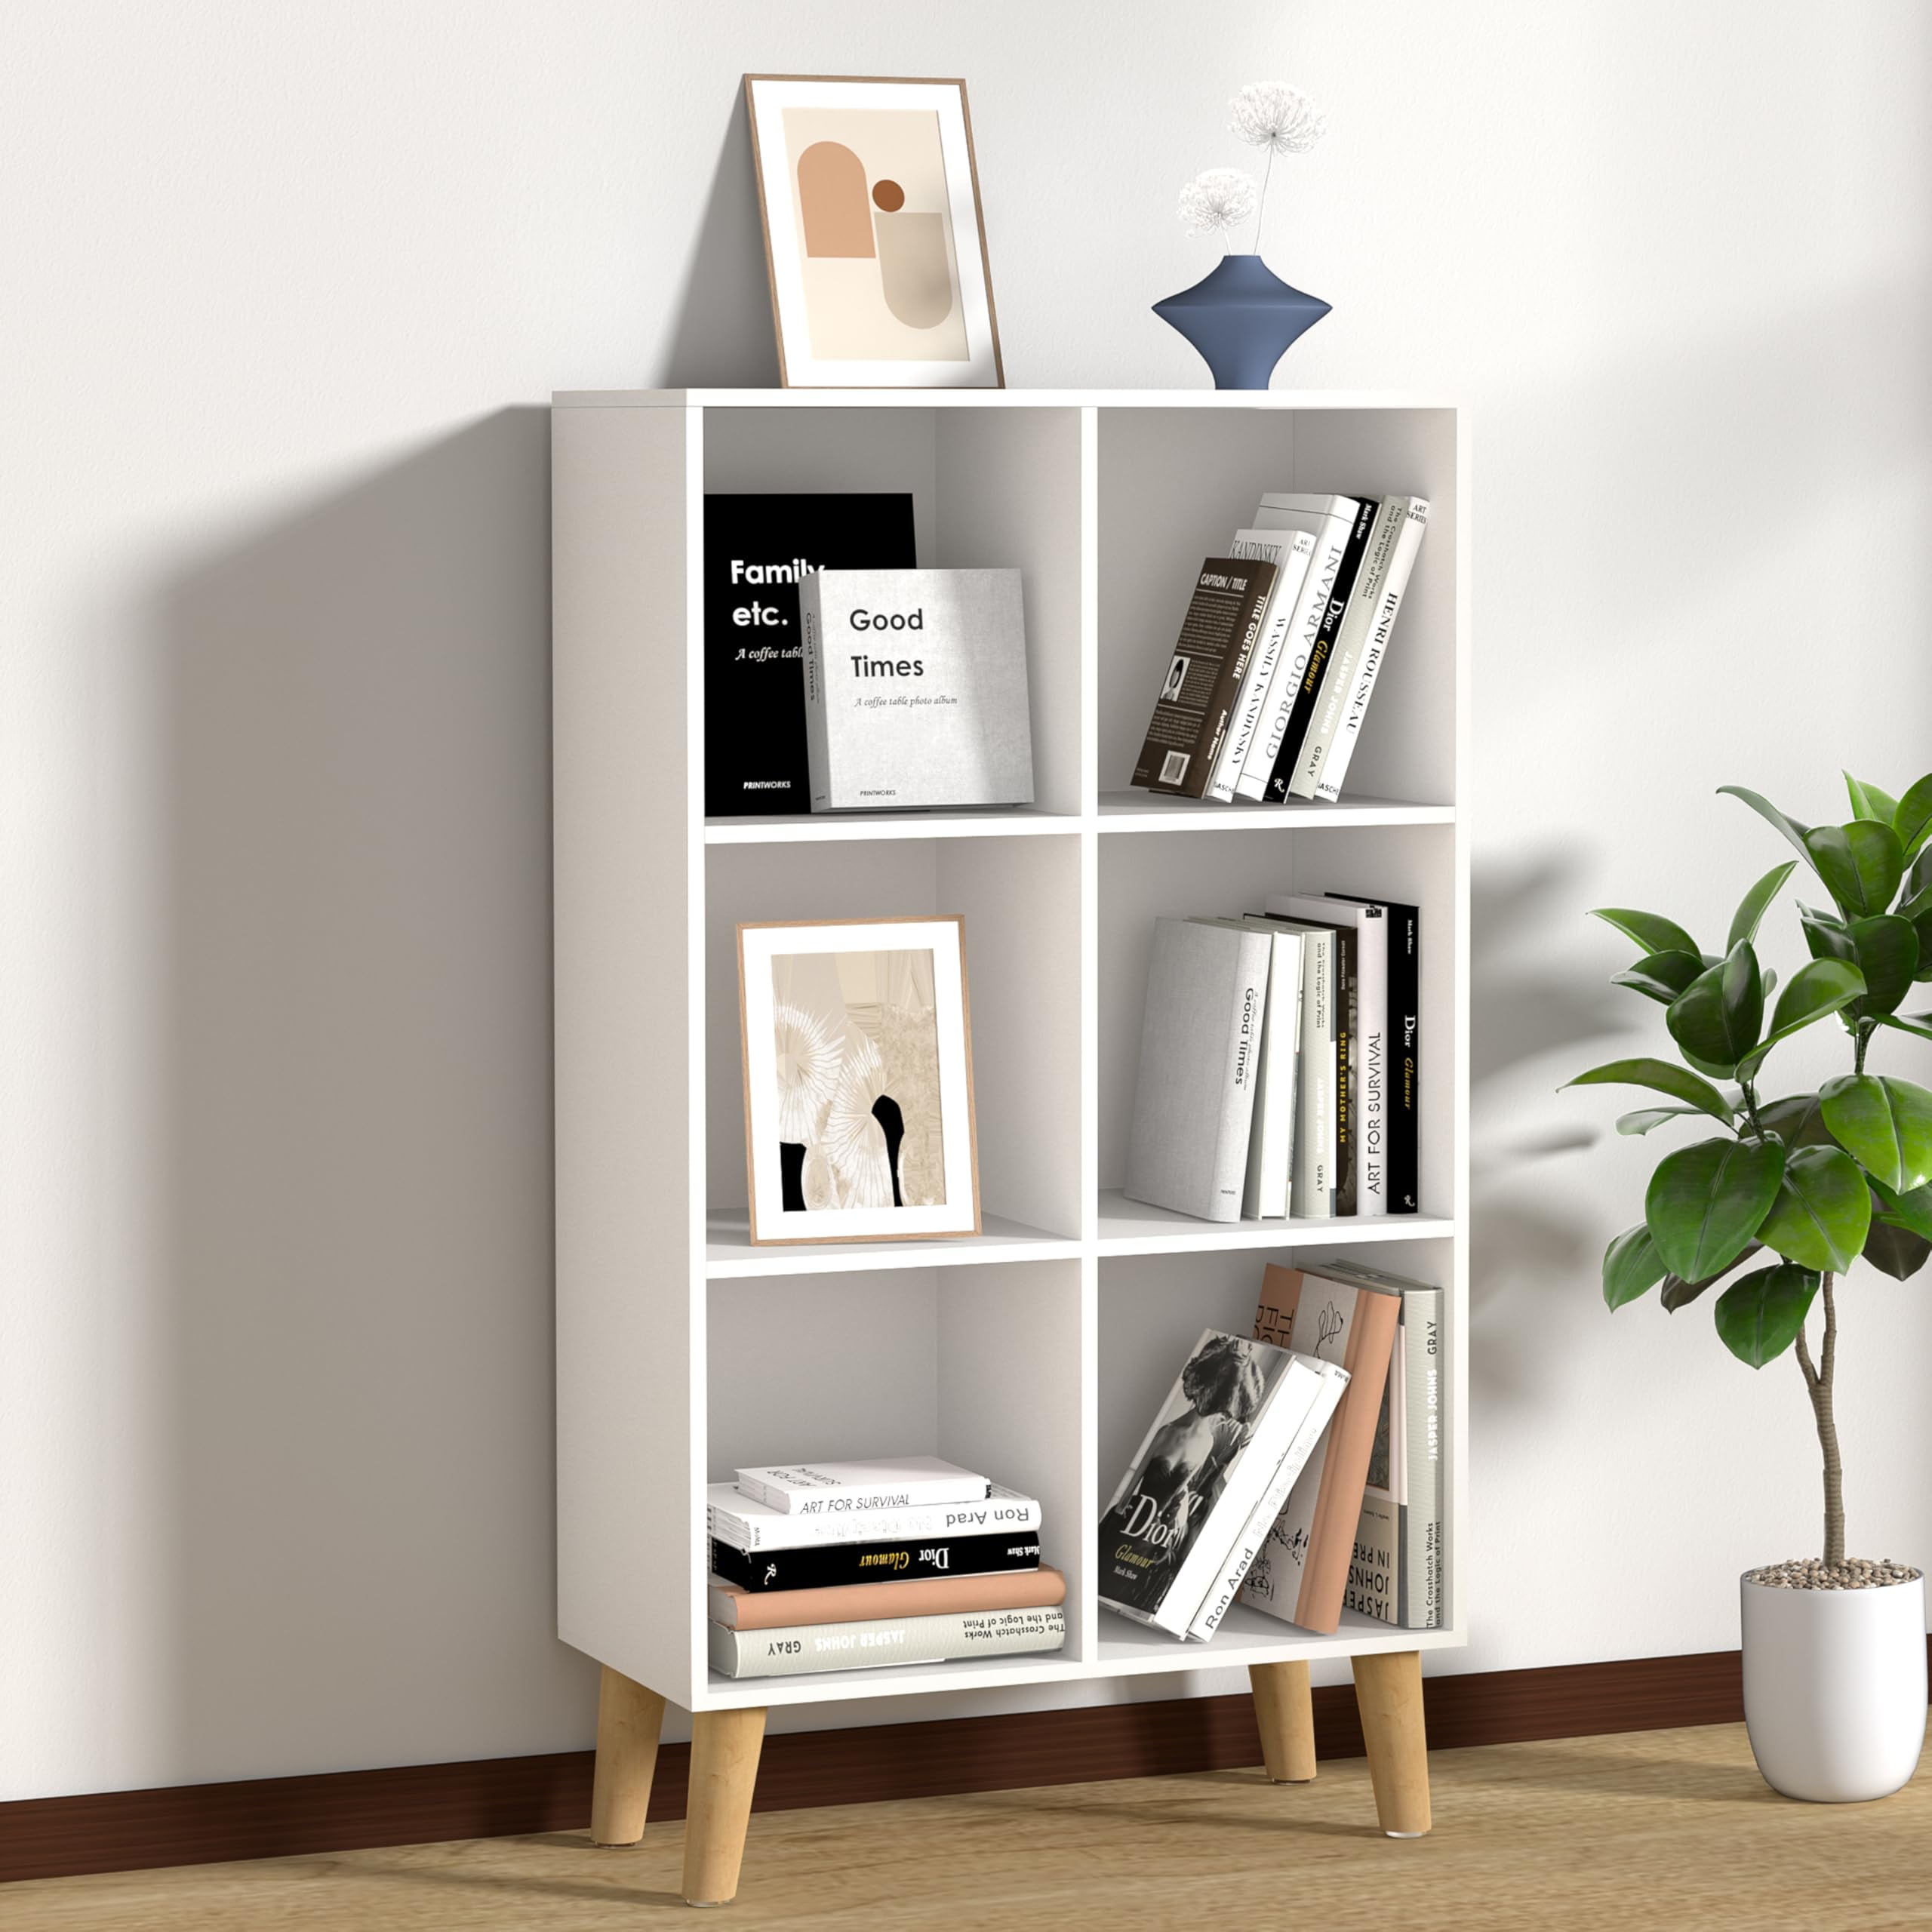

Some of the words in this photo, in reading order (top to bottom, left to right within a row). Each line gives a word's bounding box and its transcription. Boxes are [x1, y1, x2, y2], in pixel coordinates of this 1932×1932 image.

[1387, 505, 1395, 523] and
[1381, 525, 1390, 540] the
[1374, 542, 1385, 565] Logic
[1200, 573, 1228, 589] CAPTION
[1232, 577, 1247, 591] TITLE
[1361, 577, 1373, 598] Print
[732, 601, 788, 626] etc.
[1251, 595, 1266, 620] TITLE
[1323, 597, 1345, 632] Dior
[850, 608, 924, 631] Good
[1373, 592, 1398, 649] HENRI
[1241, 623, 1257, 651] GOES
[734, 648, 746, 661] A
[749, 647, 779, 662] coffee
[1266, 654, 1306, 759] GIORGIO
[1303, 545, 1343, 647] ARMANI
[851, 654, 924, 677] Times
[1232, 653, 1247, 679] HERE
[1304, 640, 1328, 694] Glamour
[854, 697, 862, 707] A
[864, 696, 888, 709] coffee
[889, 696, 908, 706] table
[909, 695, 933, 708] photo
[934, 695, 958, 705] album
[1346, 648, 1381, 736] ROUSSEAU
[1216, 709, 1228, 737] Author
[1307, 746, 1322, 777] GRAY
[743, 780, 791, 789] PRINTWORKS
[1241, 987, 1254, 1035] Good
[1404, 1014, 1416, 1048] Dior
[1235, 1038, 1248, 1085] Times
[1367, 1032, 1381, 1112] SURVIVAL
[1404, 1057, 1414, 1111] Glamour
[1340, 1127, 1346, 1143] MY
[1367, 1118, 1380, 1154] FOR
[1367, 1162, 1380, 1195] ART
[1427, 1321, 1438, 1355] GRAY
[1427, 1368, 1438, 1411] JOHNS
[1427, 1415, 1438, 1462] JASPER
[800, 1500, 824, 1514] ART
[828, 1498, 853, 1512] FOR
[856, 1494, 910, 1509] SURVIVAL
[994, 1507, 1029, 1521] Ron
[946, 1511, 987, 1527] Arad
[1119, 1494, 1178, 1548] Dior
[859, 1551, 910, 1571] Glamour
[918, 1547, 949, 1569] Dior
[1115, 1544, 1154, 1569] Glamour
[1377, 1549, 1389, 1569] IN
[1435, 1547, 1441, 1557] of
[1205, 1593, 1229, 1629] Ron
[1227, 1548, 1254, 1590] Arad
[1349, 1564, 1389, 1595] JOHNS
[963, 1620, 984, 1629] Print
[988, 1618, 996, 1629] of
[999, 1614, 1024, 1626] Logic
[1026, 1615, 1042, 1623] the
[1045, 1613, 1063, 1623] and
[1048, 1624, 1066, 1633] The
[815, 1634, 857, 1652] JOHNS
[860, 1629, 906, 1647] JASPER
[964, 1630, 992, 1640] Works
[996, 1626, 1044, 1638] Crosshatch
[768, 1640, 801, 1656] GRAY
